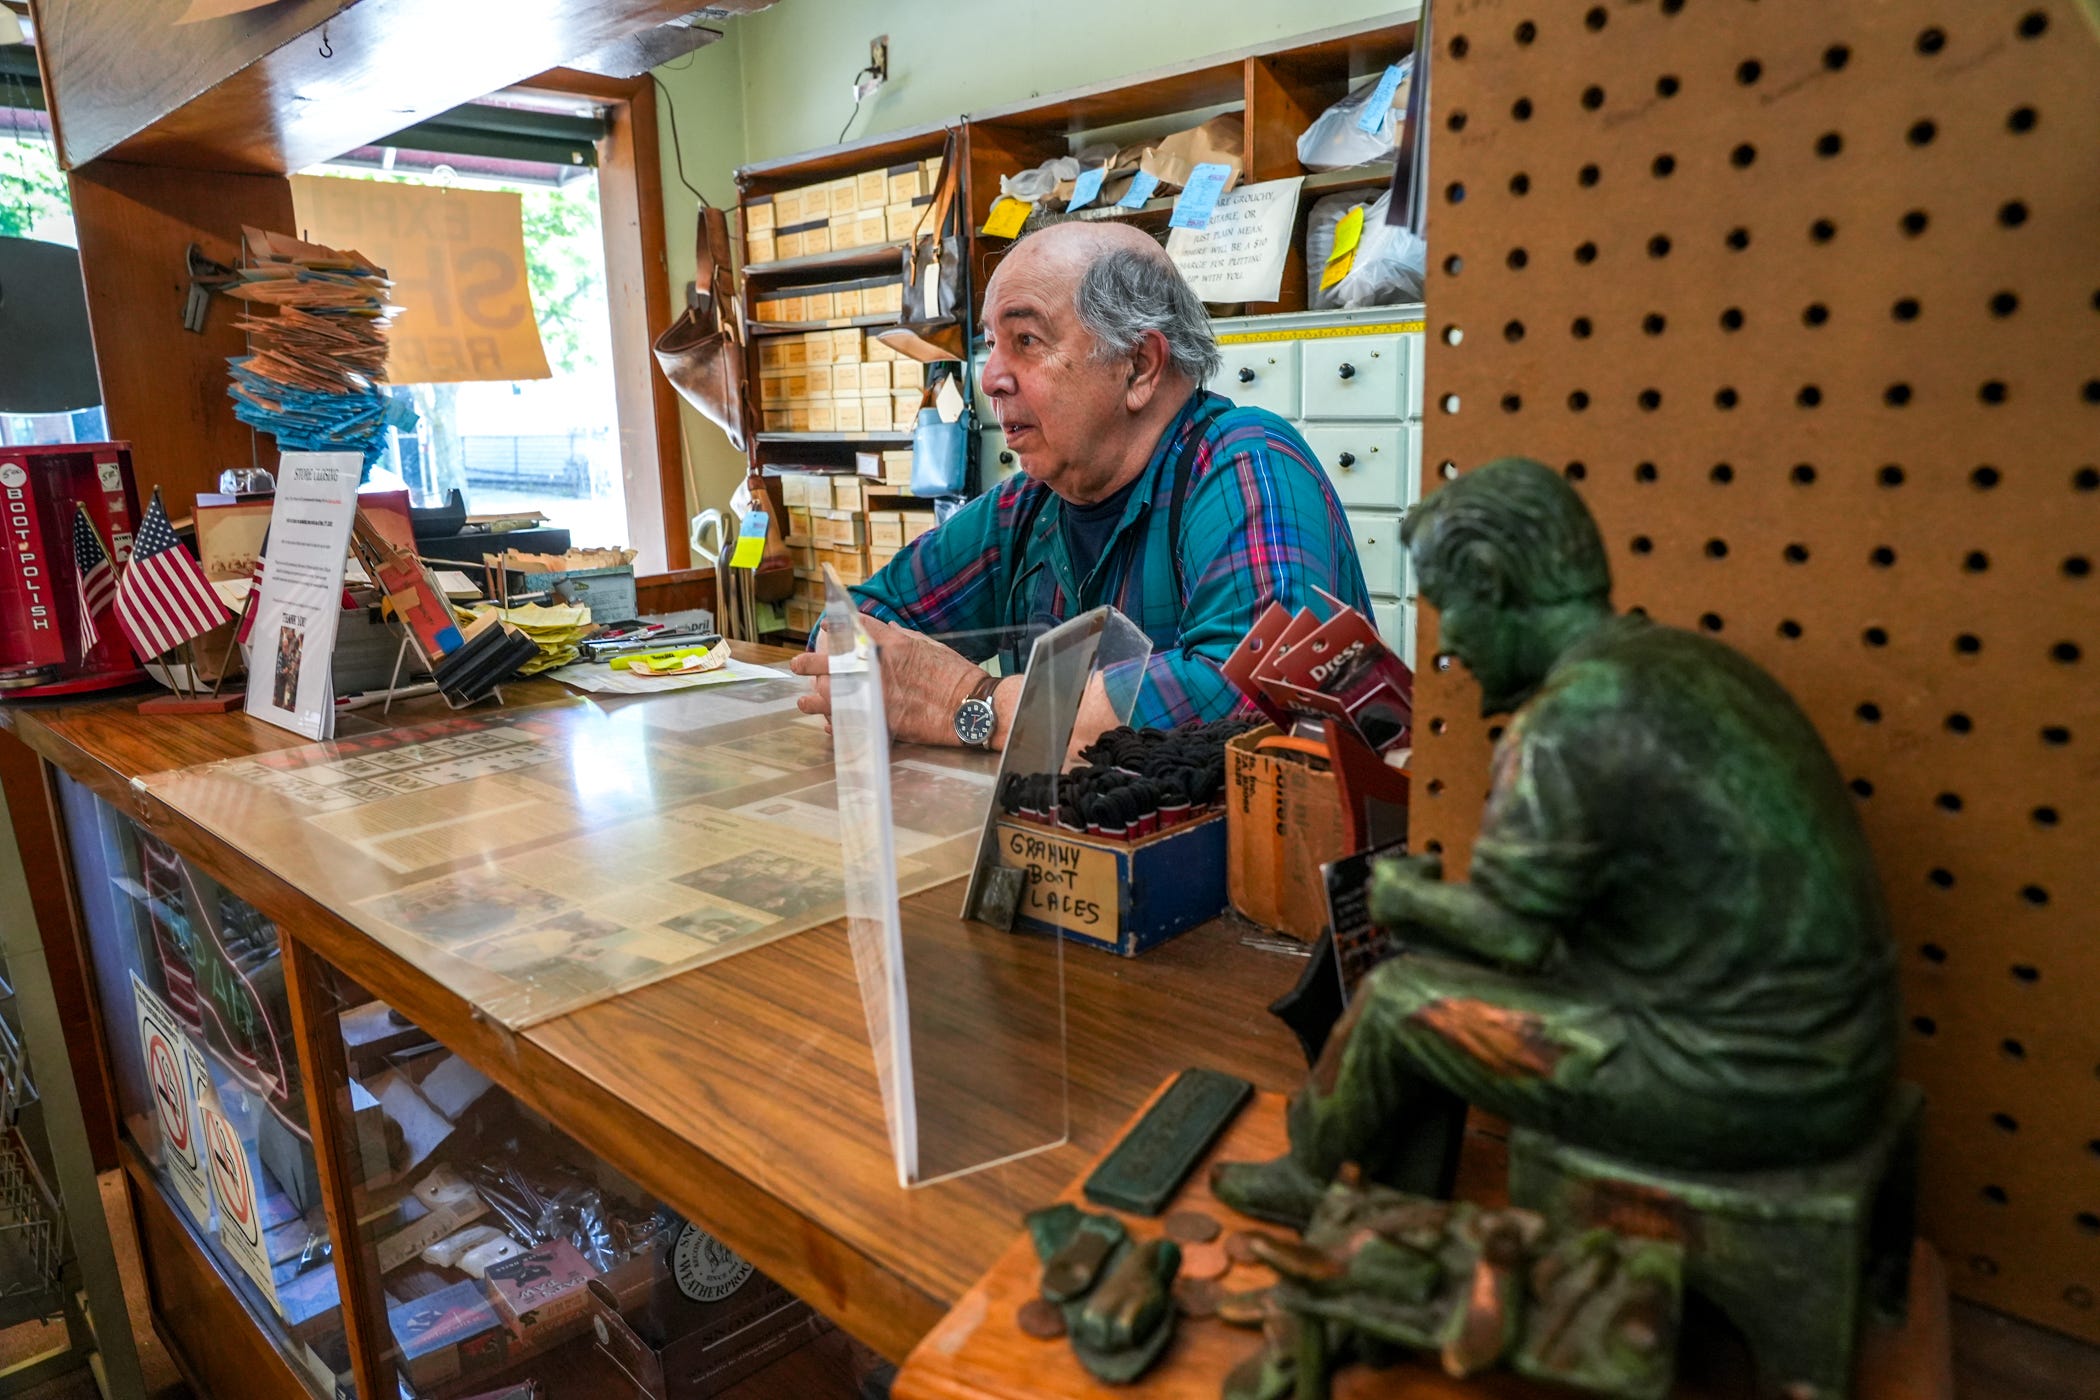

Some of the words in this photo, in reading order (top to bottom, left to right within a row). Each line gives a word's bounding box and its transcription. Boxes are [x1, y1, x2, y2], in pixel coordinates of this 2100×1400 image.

[1244, 209, 1258, 220] OR
[1193, 232, 1211, 244] JUST
[1213, 228, 1235, 240] PLAIN
[1231, 242, 1242, 252] BE
[1201, 273, 1223, 282] WITH
[1228, 254, 1262, 267] PUTTING
[6, 487, 31, 540] BOOT
[20, 552, 50, 631] POLISH
[1309, 639, 1366, 683] Dress
[1009, 832, 1081, 870] GRANNY
[1030, 890, 1101, 924] LACES
[679, 1259, 754, 1298] WEATHERPROO
